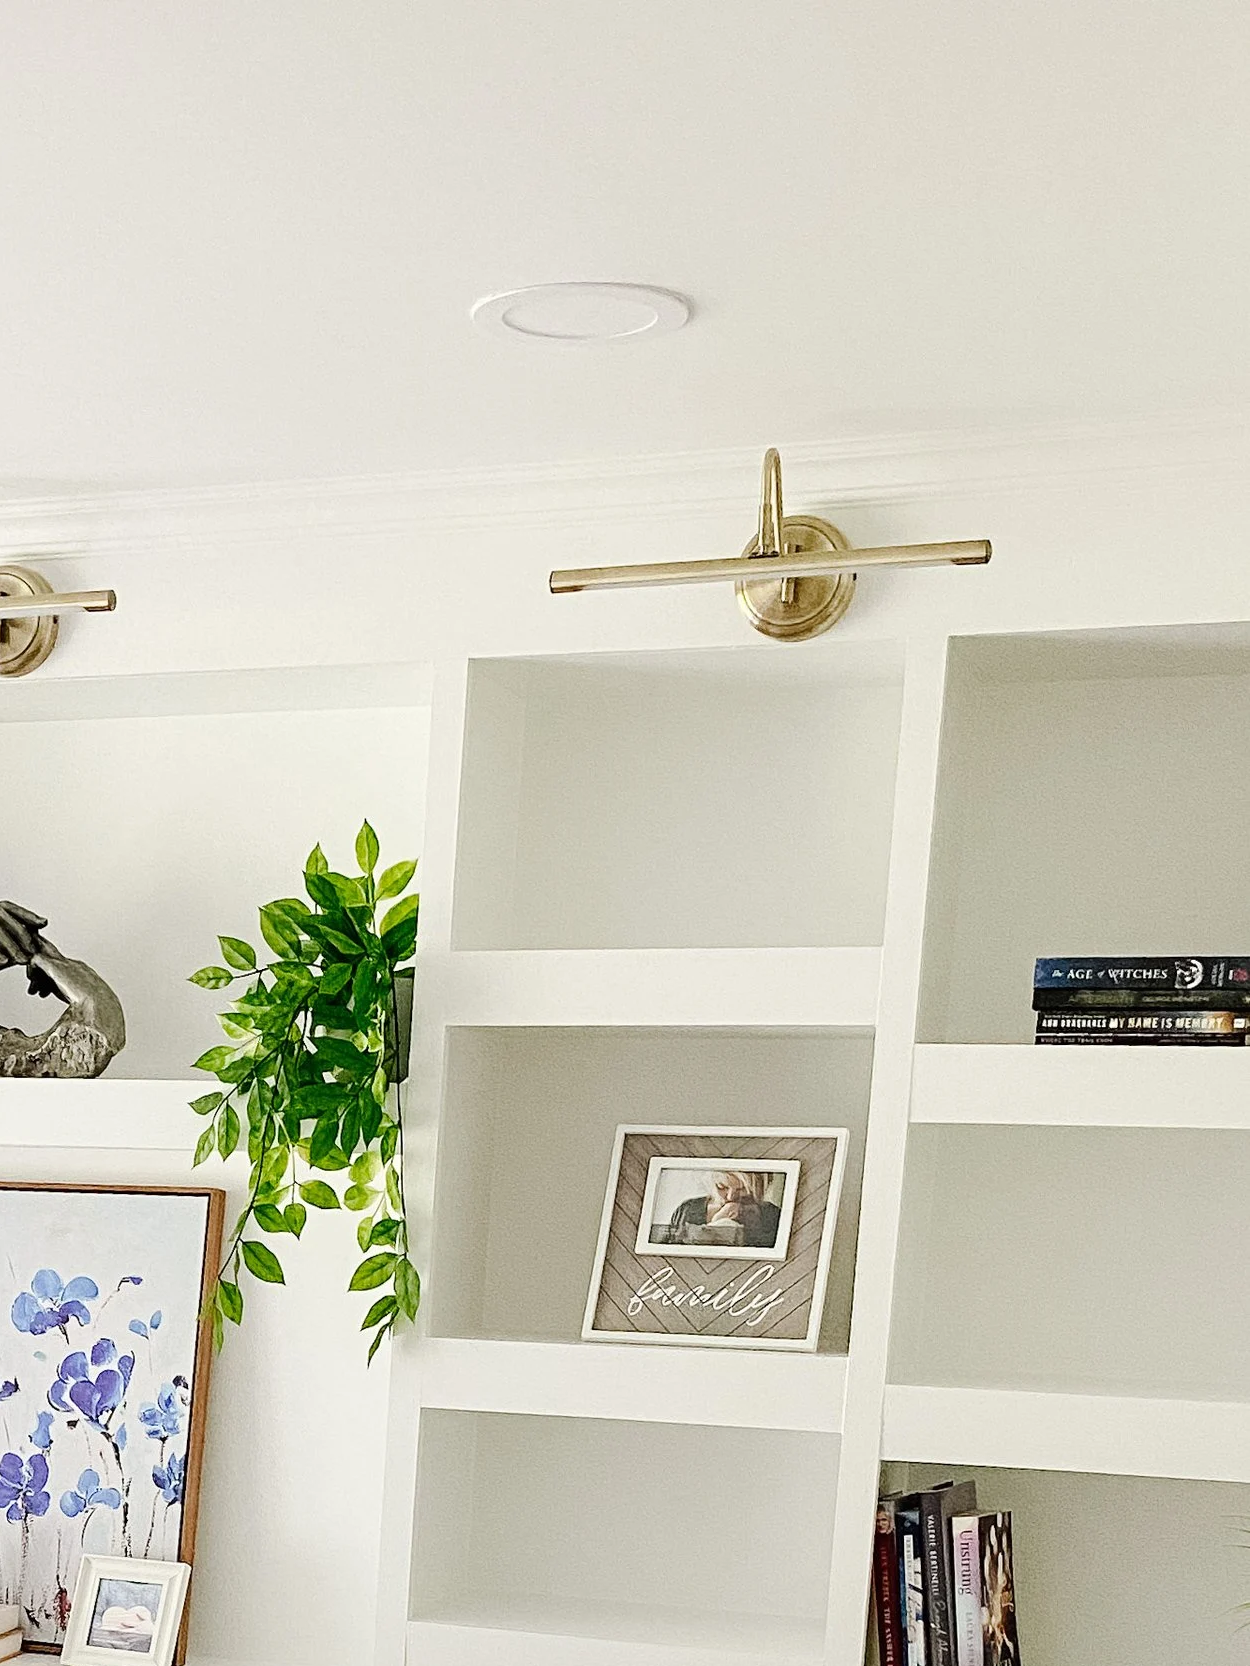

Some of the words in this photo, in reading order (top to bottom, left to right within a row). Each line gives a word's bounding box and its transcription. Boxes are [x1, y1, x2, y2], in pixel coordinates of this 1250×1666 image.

[1066, 969, 1093, 979] AGE
[1108, 968, 1168, 985] WITCHES
[1108, 1017, 1126, 1029] MY
[1128, 1017, 1159, 1029] NAME
[1160, 1018, 1173, 1029] IS
[1174, 1017, 1225, 1029] MEMORY
[626, 1263, 785, 1327] family
[926, 1514, 937, 1547] VALERIE
[957, 1529, 974, 1596] Unstrung
[965, 1611, 975, 1640] LAURA
